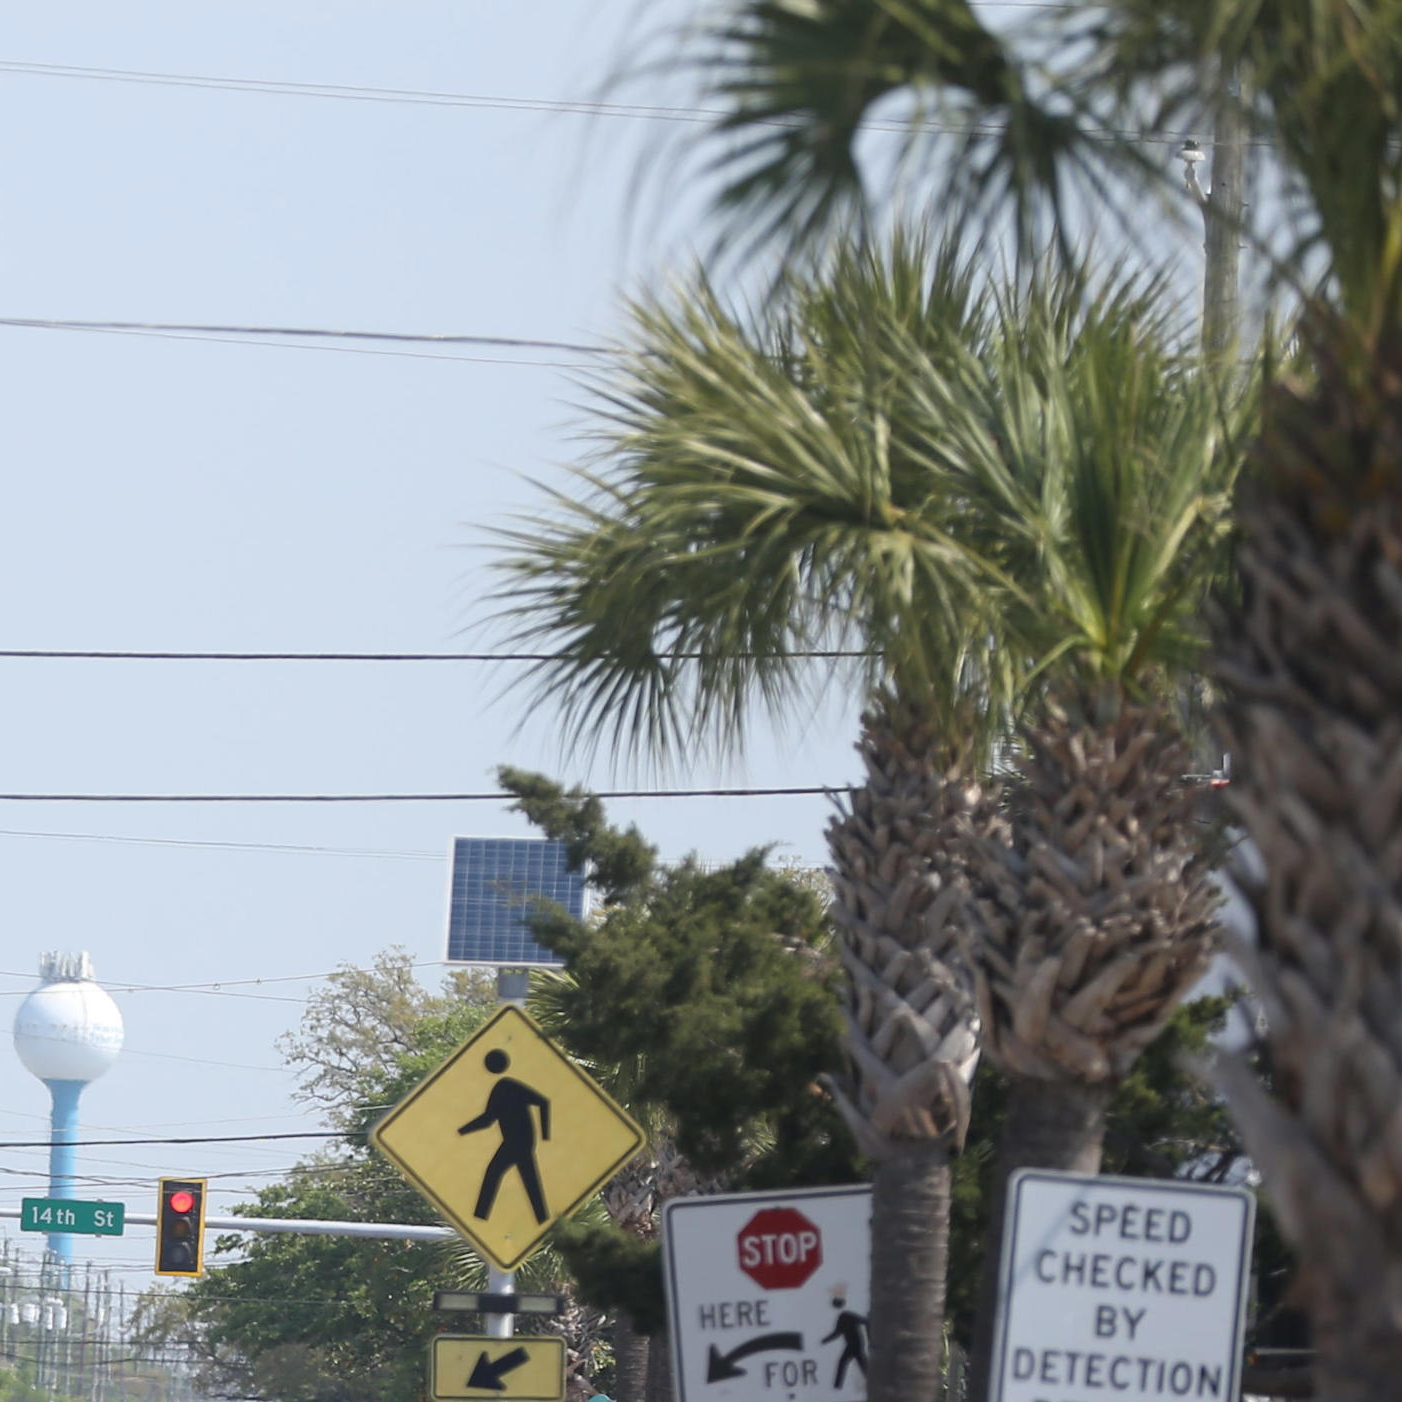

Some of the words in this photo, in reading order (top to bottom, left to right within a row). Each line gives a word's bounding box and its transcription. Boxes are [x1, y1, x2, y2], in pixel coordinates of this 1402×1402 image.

[32, 1206, 75, 1225] 14th
[94, 1210, 114, 1227] St
[1070, 1201, 1191, 1243] SPEED
[743, 1231, 817, 1267] STOP
[1036, 1249, 1216, 1298] CHECKED
[700, 1300, 771, 1329] HERE
[1096, 1305, 1146, 1341] BY
[764, 1359, 818, 1389] FOR
[1012, 1347, 1222, 1398] DETECTION
